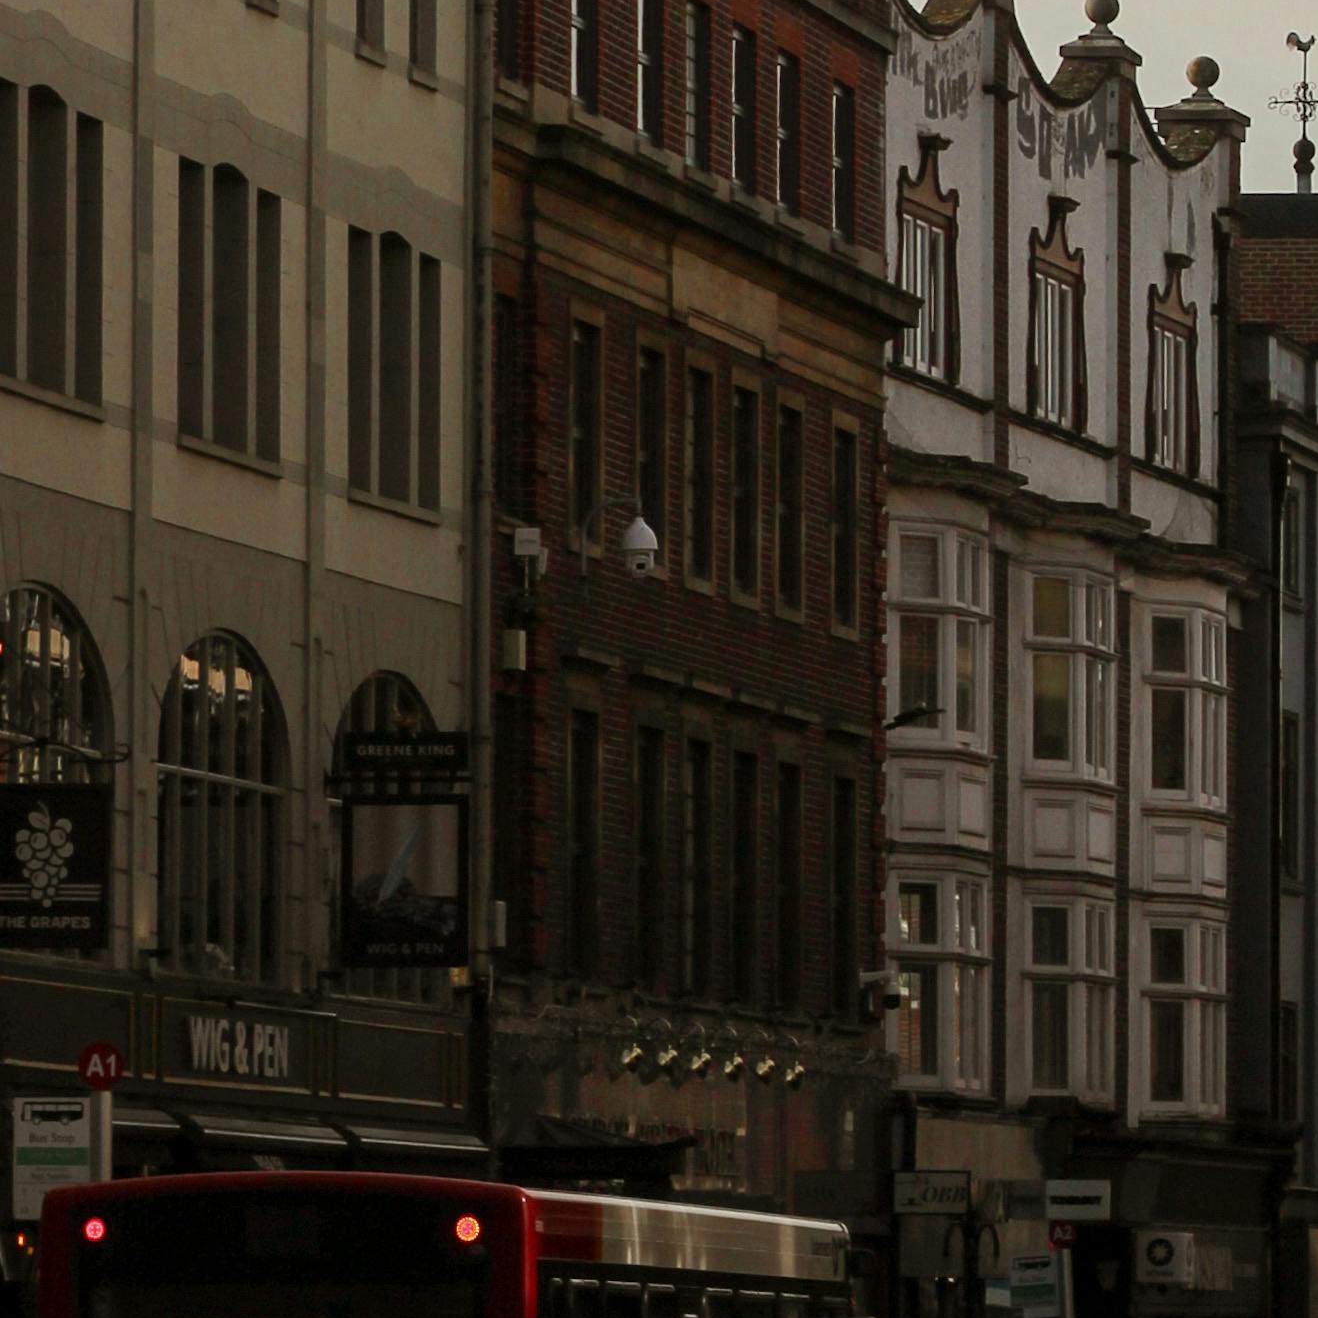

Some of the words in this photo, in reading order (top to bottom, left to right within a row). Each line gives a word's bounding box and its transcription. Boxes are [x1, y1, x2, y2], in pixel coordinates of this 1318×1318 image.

[355, 744, 415, 756] GREENE
[418, 744, 456, 755] KING
[0, 915, 26, 929] THE
[30, 915, 91, 929] GRAPES
[416, 943, 445, 955] PEN
[189, 1015, 230, 1073] WIG
[234, 1020, 249, 1075] &
[252, 1023, 289, 1079] PEN
[85, 1053, 117, 1078] A1
[29, 1133, 48, 1143] Bus
[51, 1133, 76, 1145] Stop
[1052, 1225, 1073, 1241] A2
